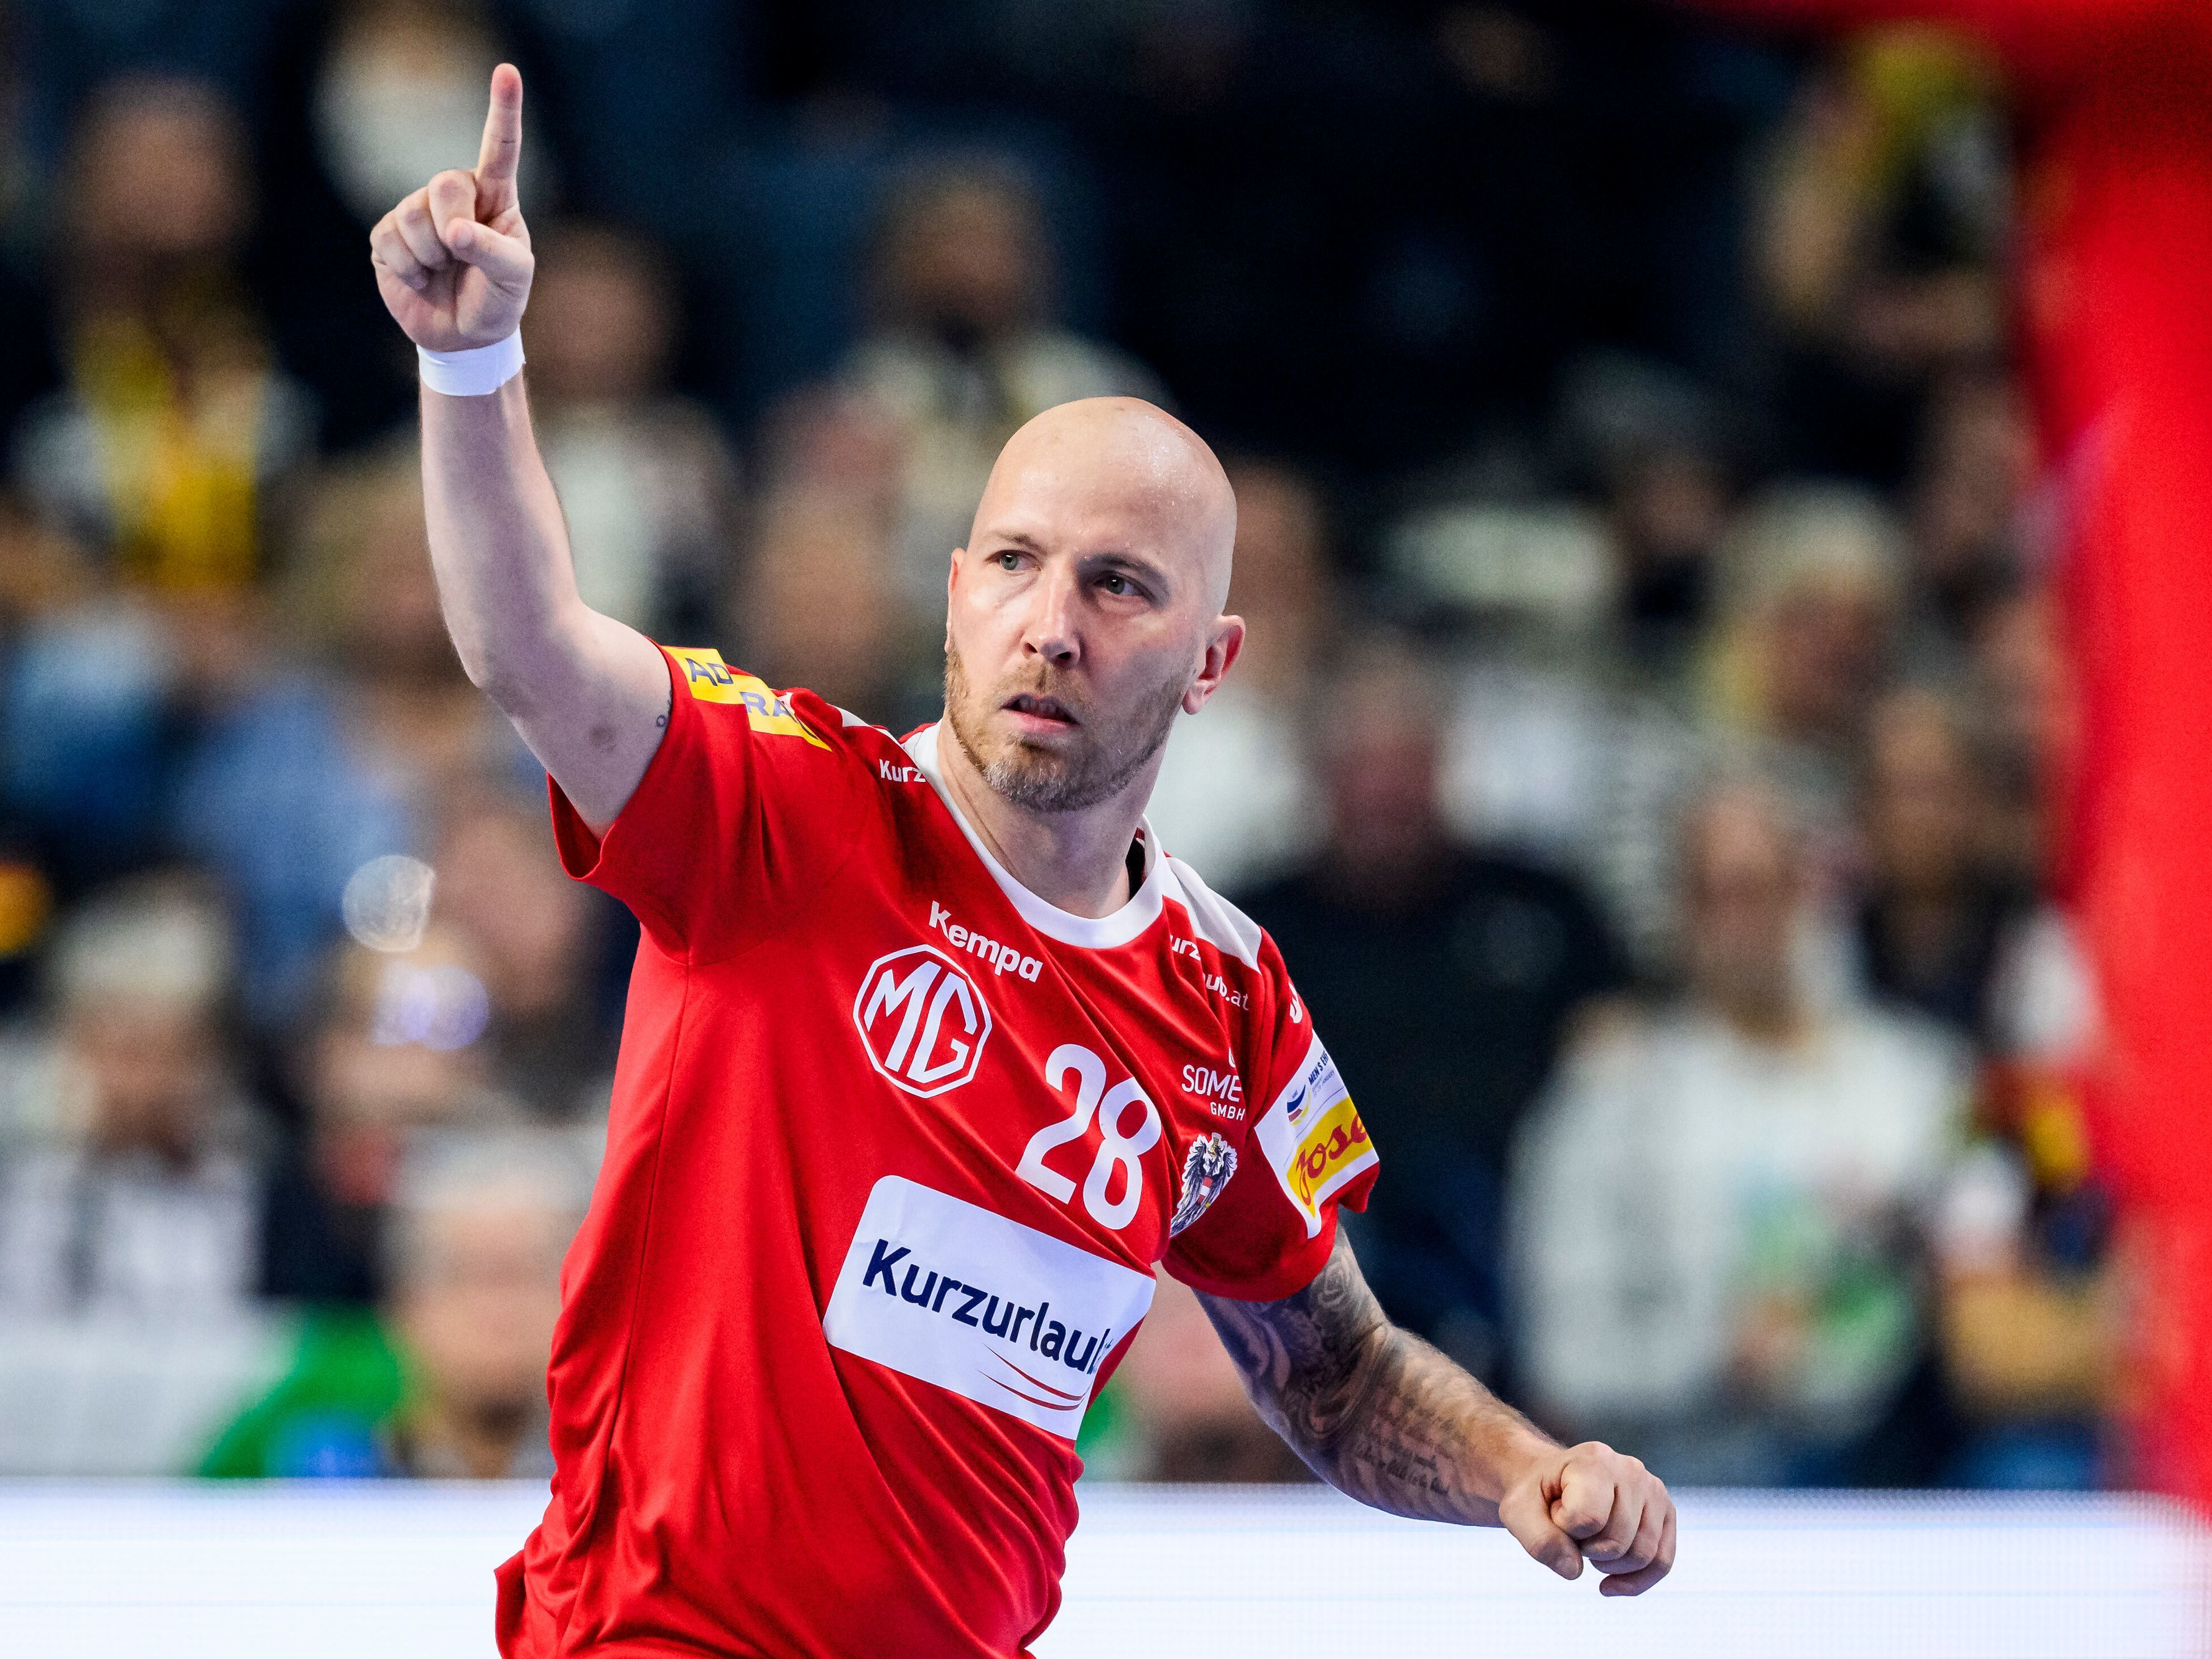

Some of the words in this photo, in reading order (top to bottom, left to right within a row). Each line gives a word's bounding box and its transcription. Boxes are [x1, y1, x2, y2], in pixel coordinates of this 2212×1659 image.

[879, 758, 926, 783] Kurz
[929, 900, 1043, 983] Kempa
[863, 960, 978, 1084] MG
[1202, 972, 1248, 1011] ub.at
[1015, 1044, 1162, 1230] 28
[1210, 1102, 1245, 1121] GMBH
